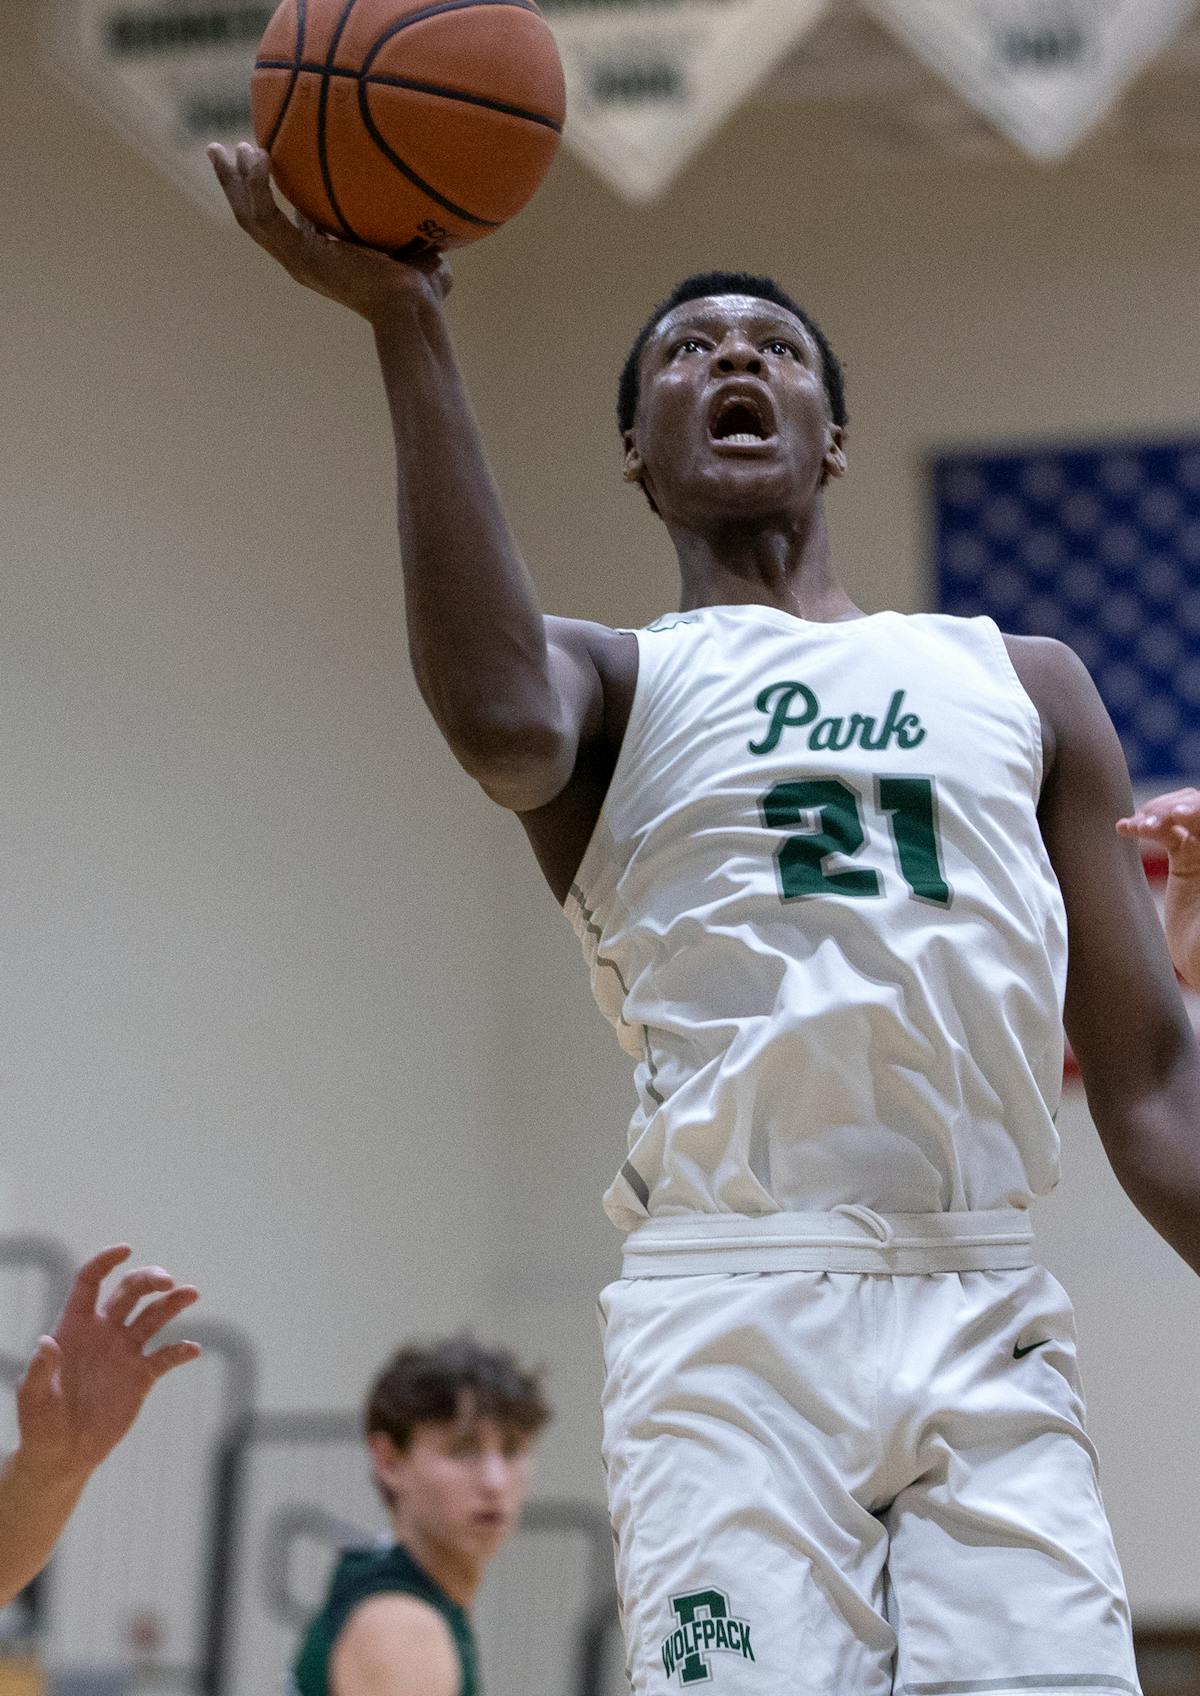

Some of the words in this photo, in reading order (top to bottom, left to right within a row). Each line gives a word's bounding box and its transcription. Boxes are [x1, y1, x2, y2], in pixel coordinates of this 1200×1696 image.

[748, 680, 927, 756] Park
[757, 772, 955, 910] 21
[660, 1618, 757, 1681] WOLFPACK
